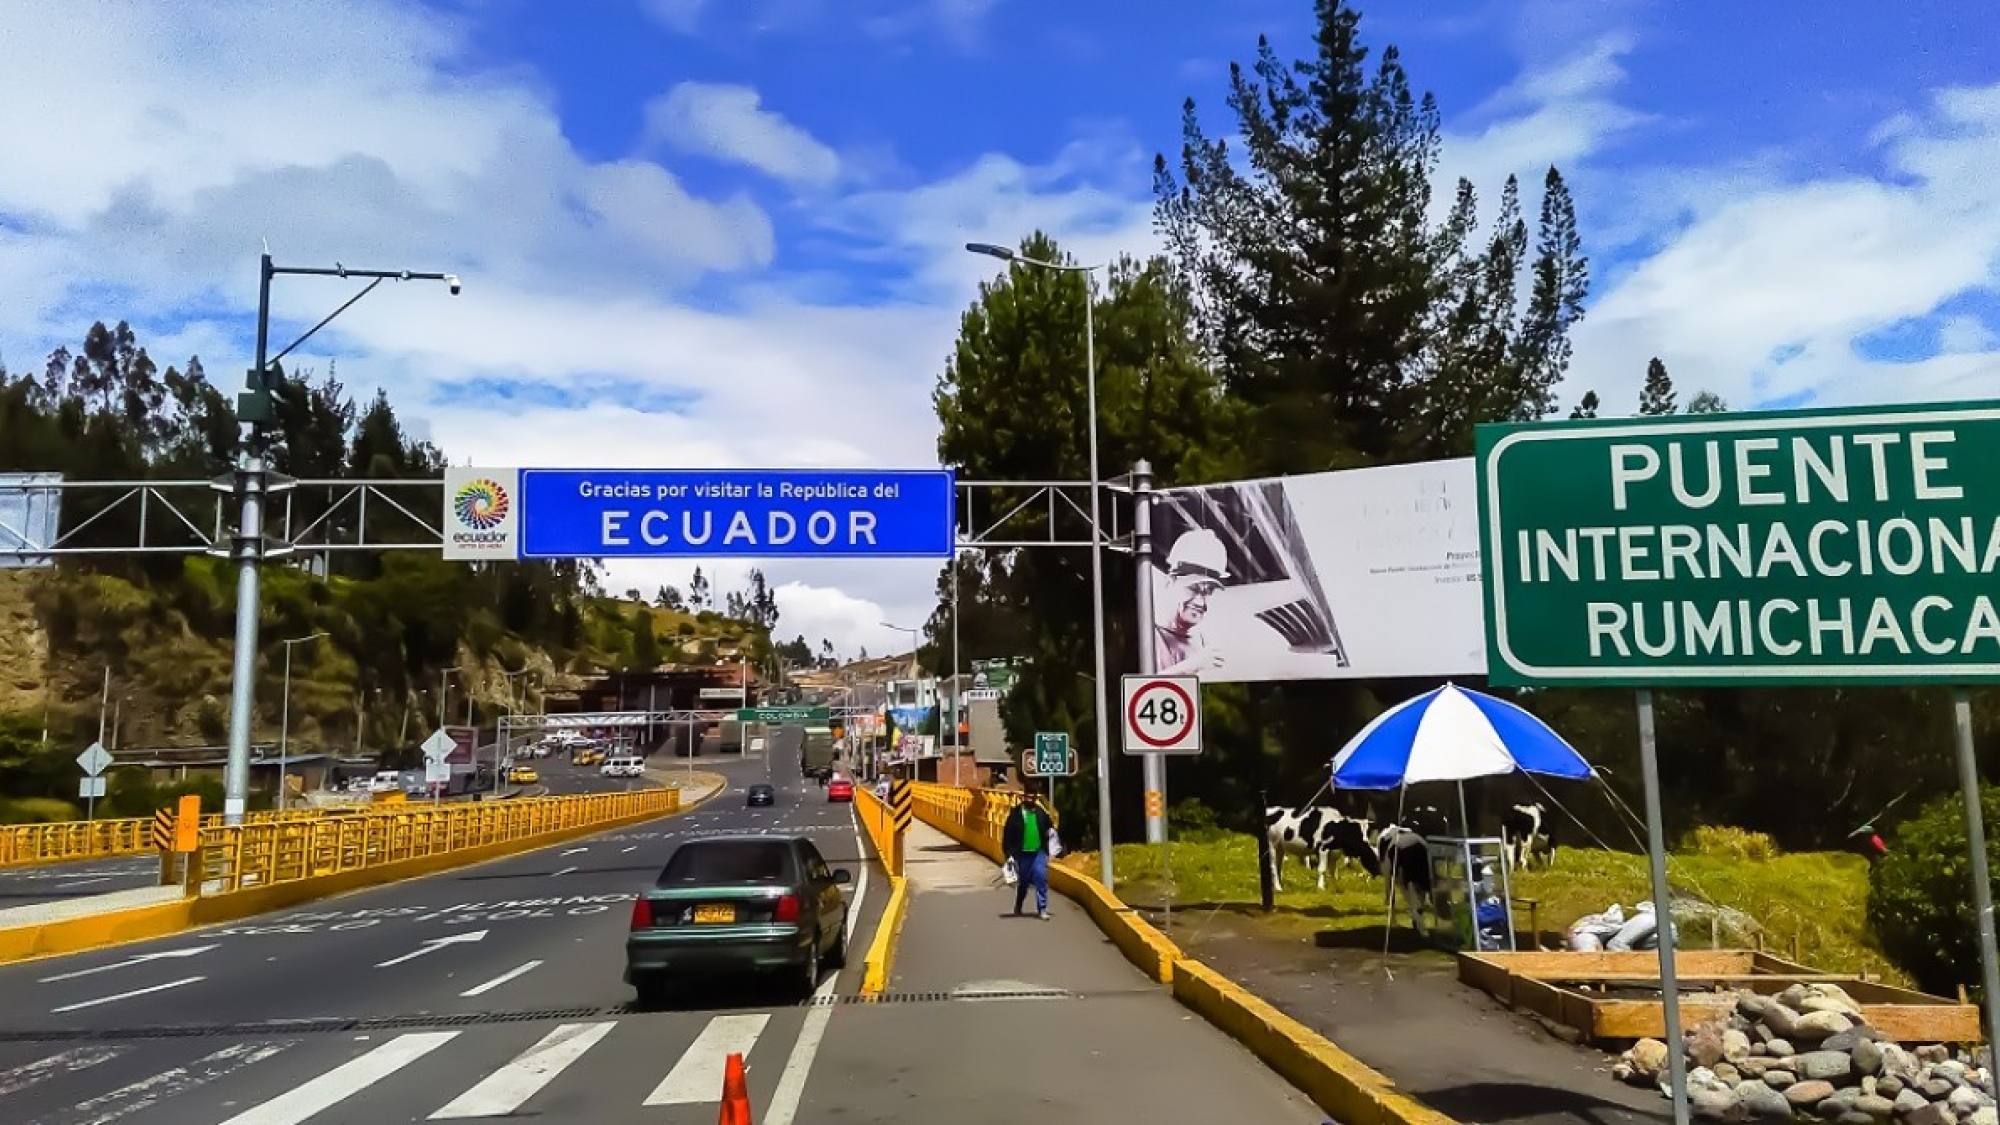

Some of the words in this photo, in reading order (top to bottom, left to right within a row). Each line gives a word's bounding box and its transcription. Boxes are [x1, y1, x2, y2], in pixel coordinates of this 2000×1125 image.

[1609, 430, 1964, 510] PUENTE
[579, 481, 651, 498] Gracias
[657, 484, 688, 501] por
[694, 481, 752, 498] visitar
[757, 481, 773, 498] la
[779, 480, 868, 502] República
[874, 481, 899, 498] del
[453, 531, 507, 543] ecuador
[601, 510, 878, 546] ECUADOR
[1586, 595, 2000, 659] RUMICHACA
